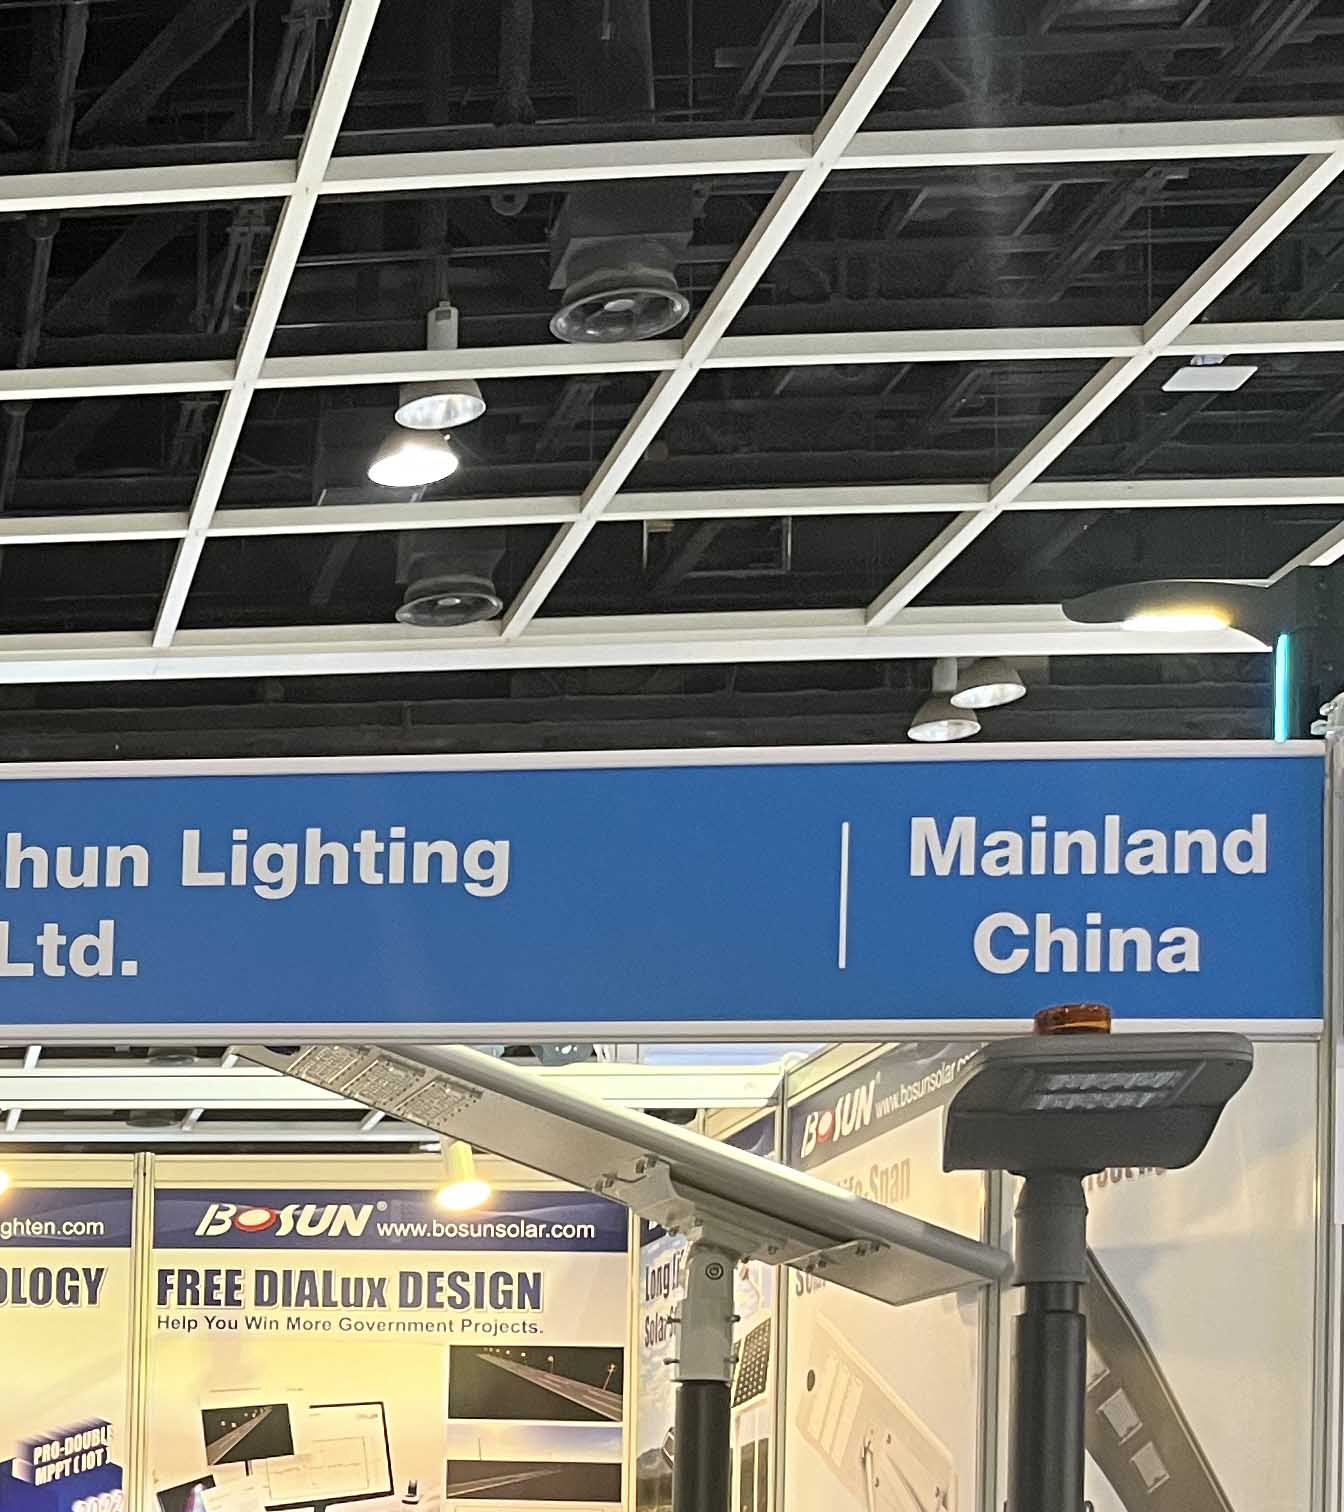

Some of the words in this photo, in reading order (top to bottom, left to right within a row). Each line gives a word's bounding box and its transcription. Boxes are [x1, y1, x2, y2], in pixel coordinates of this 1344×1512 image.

[182, 827, 509, 899] Lighting
[911, 814, 1266, 877] Mainland
[974, 913, 1199, 974] China
[801, 1080, 875, 1158] BOSUN
[194, 1203, 374, 1237] BOSUN
[376, 1219, 595, 1239] www.bosunsolar.com
[157, 1269, 242, 1307] FREE
[255, 1269, 387, 1308] DIALux
[399, 1271, 543, 1310] DESIGN
[157, 1315, 198, 1333] Help
[204, 1316, 238, 1331] You
[244, 1316, 279, 1331] Win
[286, 1316, 332, 1331] More
[339, 1316, 455, 1333] Government
[461, 1318, 544, 1336] Projects.
